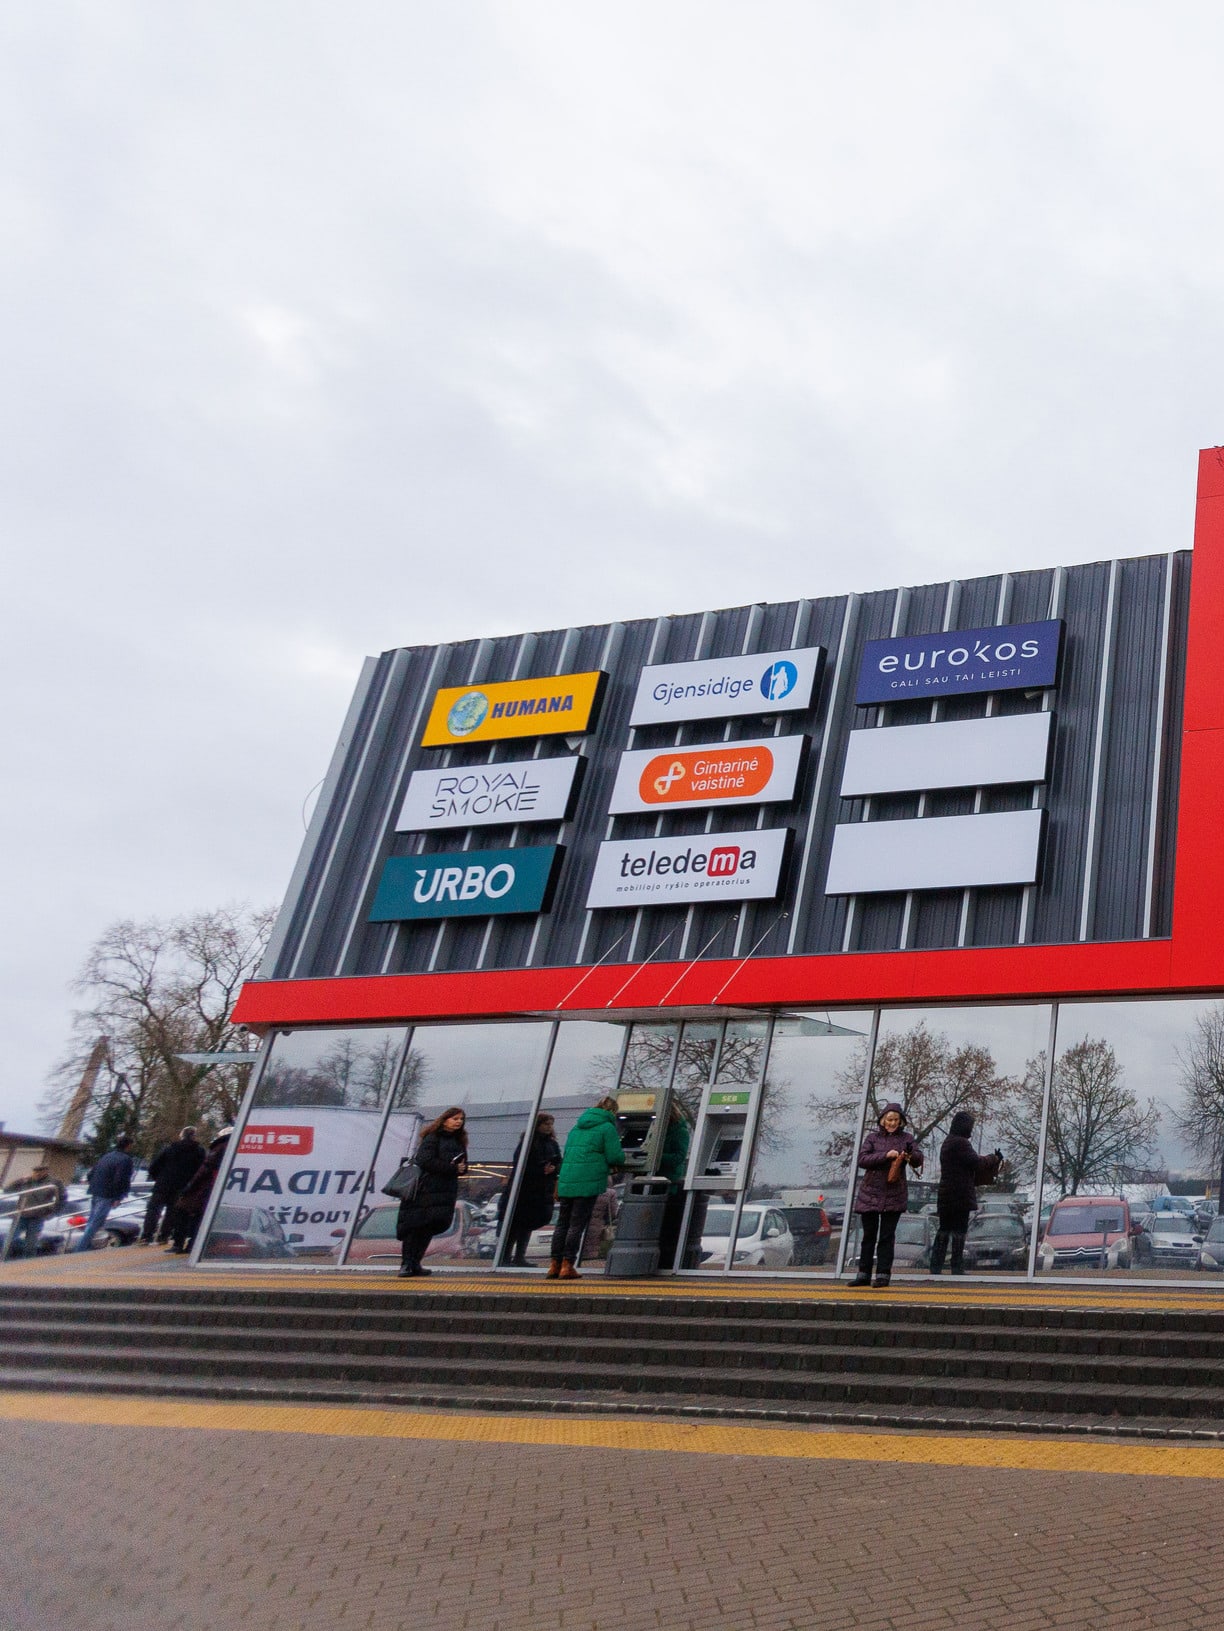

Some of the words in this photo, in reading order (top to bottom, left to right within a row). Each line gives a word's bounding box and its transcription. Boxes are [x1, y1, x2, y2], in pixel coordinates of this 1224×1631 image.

[879, 639, 1039, 673] eurokos
[925, 676, 949, 685] SAU
[955, 673, 974, 681] TAI
[981, 668, 1021, 679] LEISTI
[653, 677, 753, 705] Gjensidige
[491, 695, 573, 718] HUMANA
[694, 757, 758, 776] Gintarinė
[435, 771, 540, 797] ROYAL
[691, 774, 745, 792] vaistinė
[430, 791, 539, 818] SMOKE
[620, 848, 757, 877] teledema
[413, 863, 515, 903] URBO
[616, 884, 661, 893] mobiliojo
[665, 881, 690, 891] ryšio
[694, 878, 751, 888] operatorius
